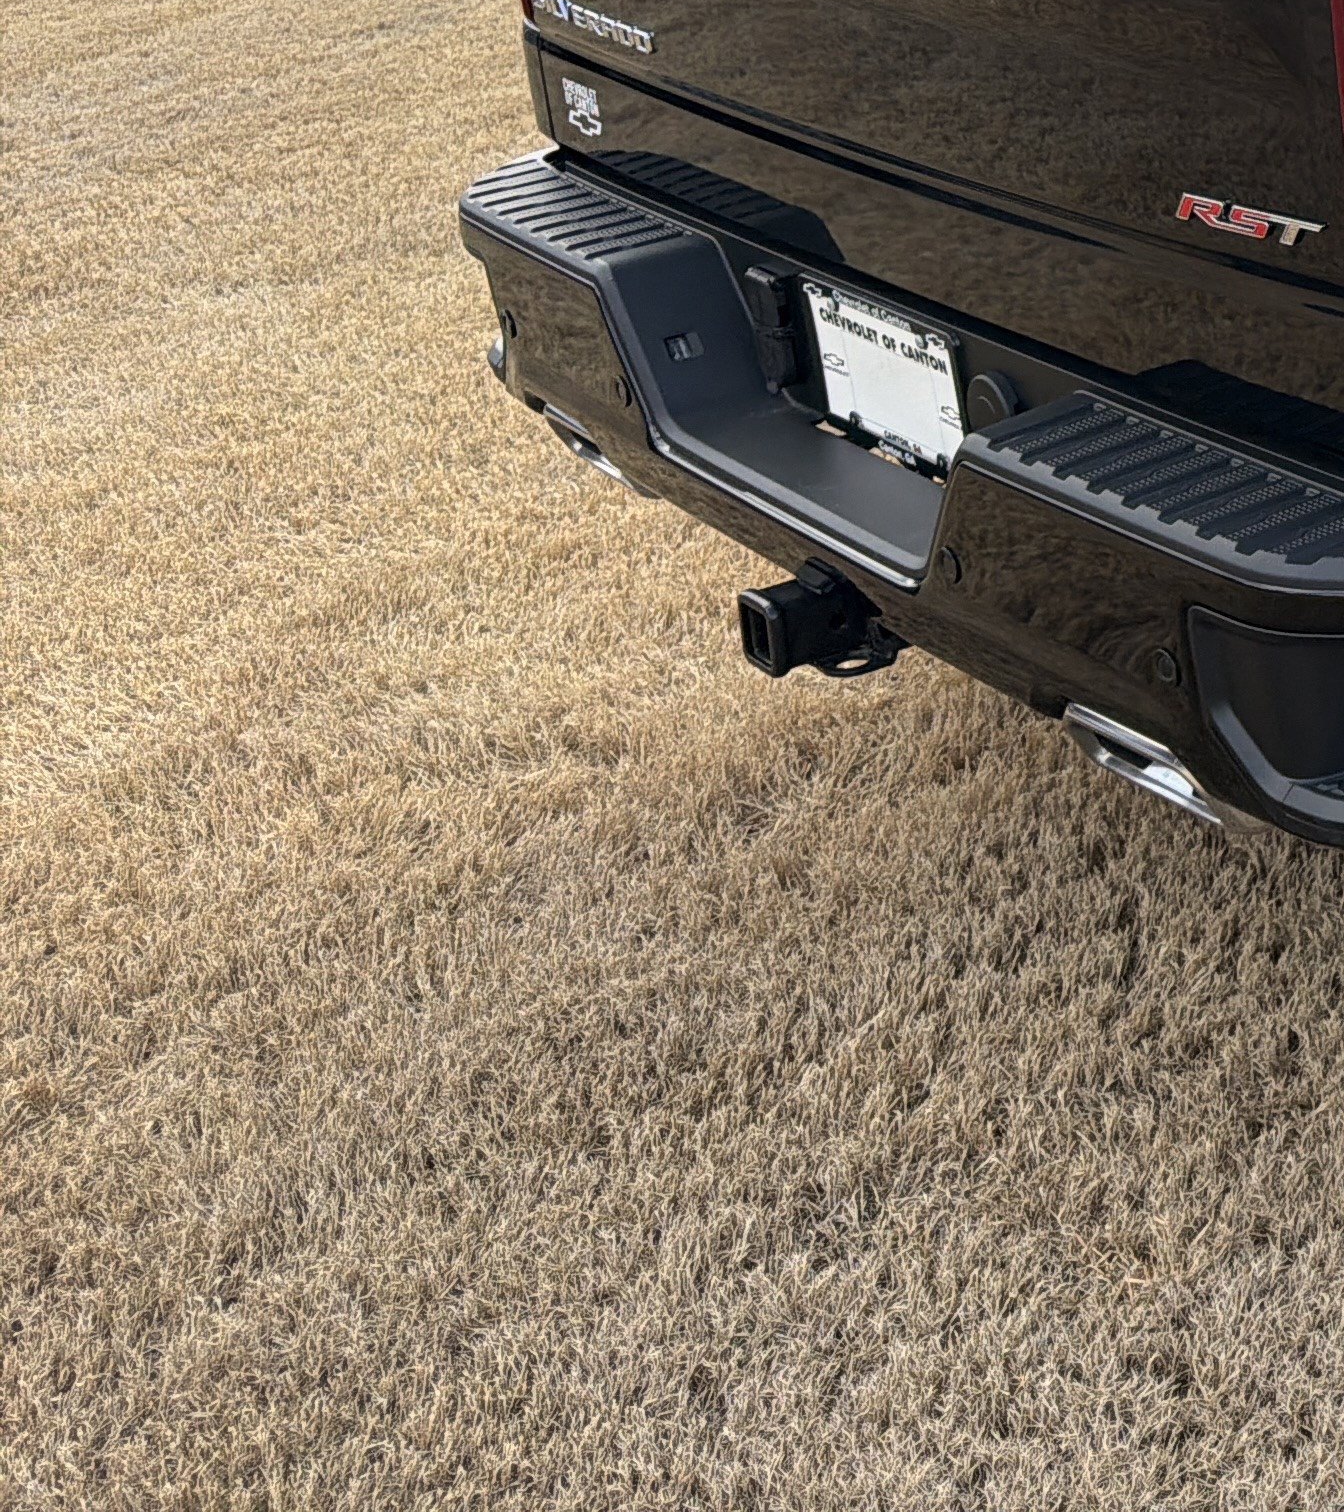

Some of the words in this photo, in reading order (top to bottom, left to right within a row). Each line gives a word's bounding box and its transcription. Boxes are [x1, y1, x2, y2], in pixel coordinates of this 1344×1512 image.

[1175, 191, 1327, 246] RST
[819, 306, 879, 343] CHEVROLET
[881, 334, 897, 352] OF
[900, 342, 948, 376] CANTON
